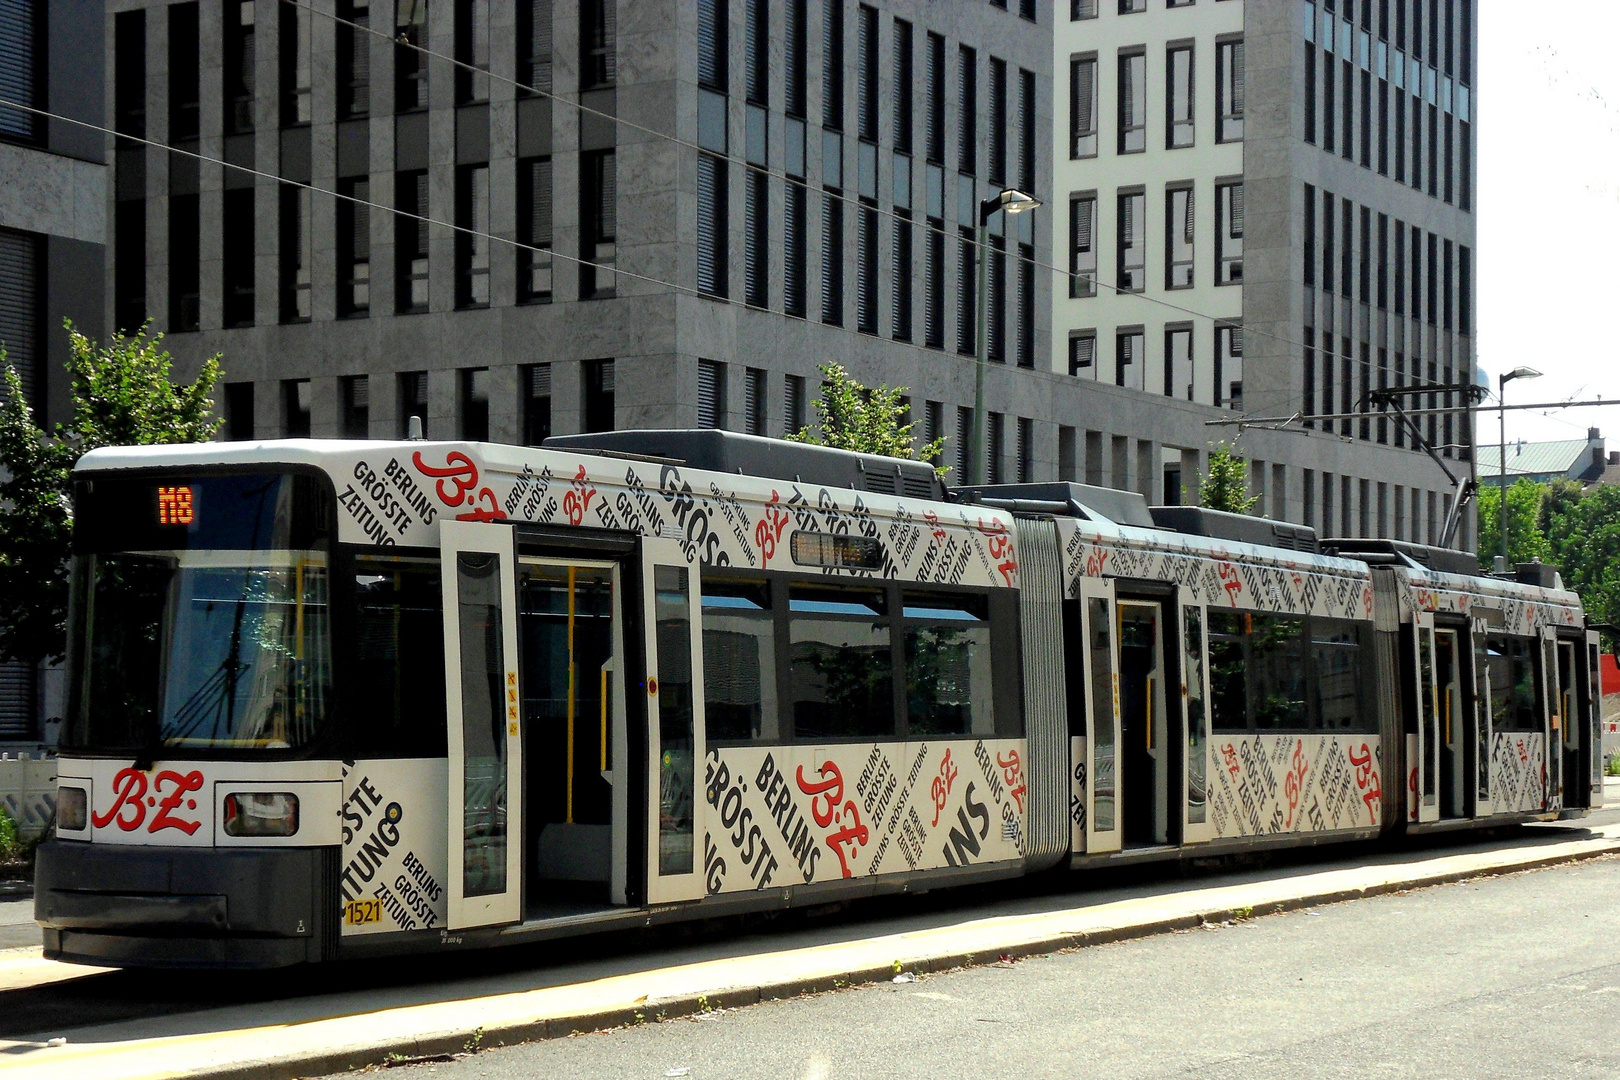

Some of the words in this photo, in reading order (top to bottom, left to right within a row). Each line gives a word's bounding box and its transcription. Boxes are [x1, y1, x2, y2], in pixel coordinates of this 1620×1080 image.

[158, 486, 193, 524] M8
[353, 461, 413, 536] GRÖSSTE
[384, 457, 438, 526] BERLINS
[504, 463, 534, 516] BERLINS
[523, 465, 554, 521] GRÖSSTE
[625, 466, 665, 537] BERLINS
[733, 524, 756, 566] ZEITUNG
[901, 526, 920, 568] ZEITUNG
[916, 540, 938, 582] ERLINS
[934, 535, 958, 583] RÖSSTE
[949, 539, 972, 584] EITUNG
[856, 743, 881, 798] BERLINS
[864, 755, 891, 814] GRÖSSTE
[974, 740, 1004, 805] BERLINS
[1240, 740, 1267, 811] GRÖSSTE
[1254, 734, 1278, 799] BERLINS
[1320, 736, 1339, 794] BERLINS
[755, 752, 822, 884] BERLINS
[868, 833, 890, 875] BERLINS
[887, 785, 910, 835] GRÖSSTE
[907, 742, 928, 789] ZEITUNG
[871, 773, 898, 830] ZEITUNG
[908, 805, 928, 845] BERLINS
[896, 832, 917, 870] ZEITUNG
[902, 818, 923, 861] GRÖSSTE
[394, 874, 439, 929] GRÖSSTE
[402, 851, 443, 903] BERLINS
[347, 901, 381, 924] 1521
[373, 882, 417, 931] ZEITUNG
